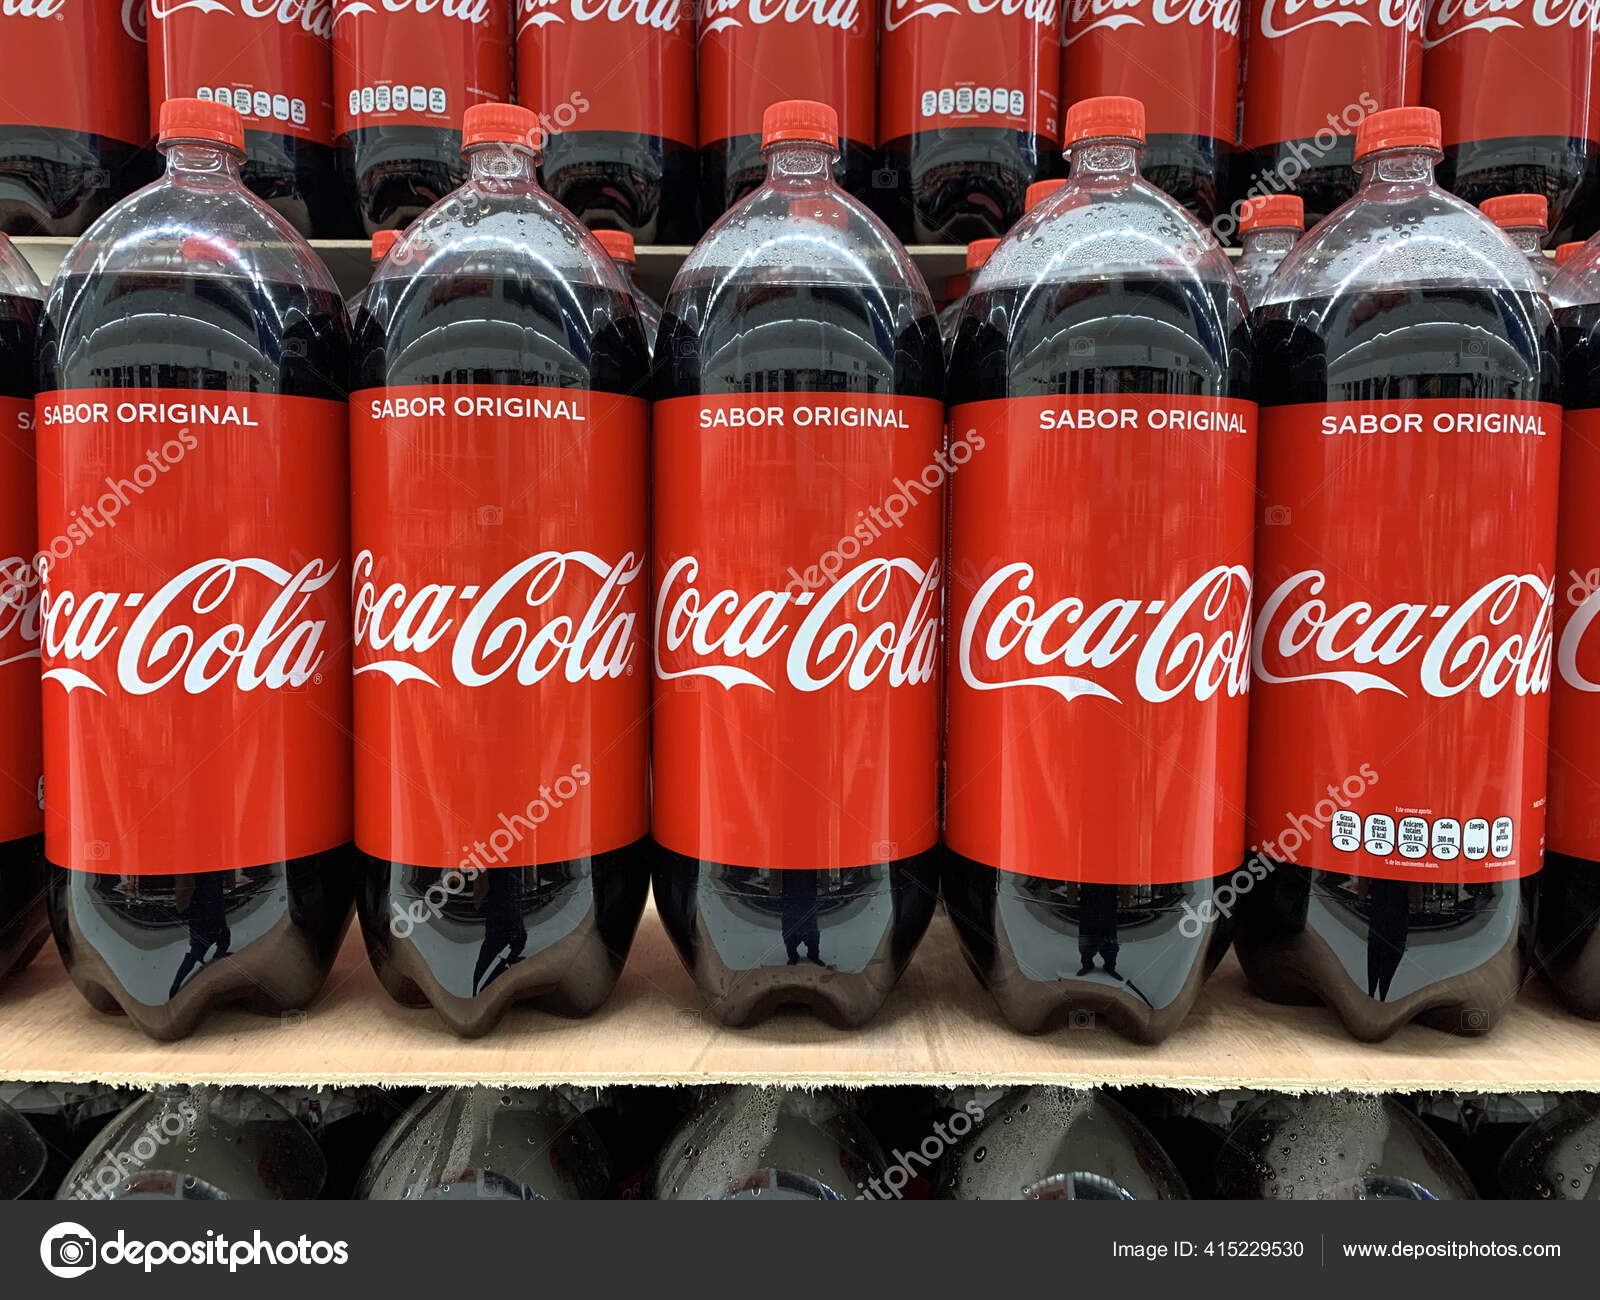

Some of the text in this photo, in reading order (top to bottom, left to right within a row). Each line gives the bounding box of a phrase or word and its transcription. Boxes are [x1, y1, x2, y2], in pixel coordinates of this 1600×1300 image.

[44, 403, 109, 426] SABOR
[117, 402, 259, 428] ORIGINAL
[371, 396, 586, 421] SABOR ORIGINAL
[699, 406, 910, 429] SABOR ORIGINAL
[1039, 408, 1248, 434] SABOR ORIGINAL
[1321, 413, 1547, 436] SABOR ORIGINAL
[40, 556, 340, 696] oca-Cola
[655, 555, 940, 692] Coca-Cola
[1340, 814, 1353, 822] Grasa
[1373, 817, 1386, 826] Otras
[1440, 822, 1453, 830] Sodio
[1377, 831, 1387, 839] kcal
[1413, 834, 1423, 842] kcal
[1437, 835, 1446, 843] 300
